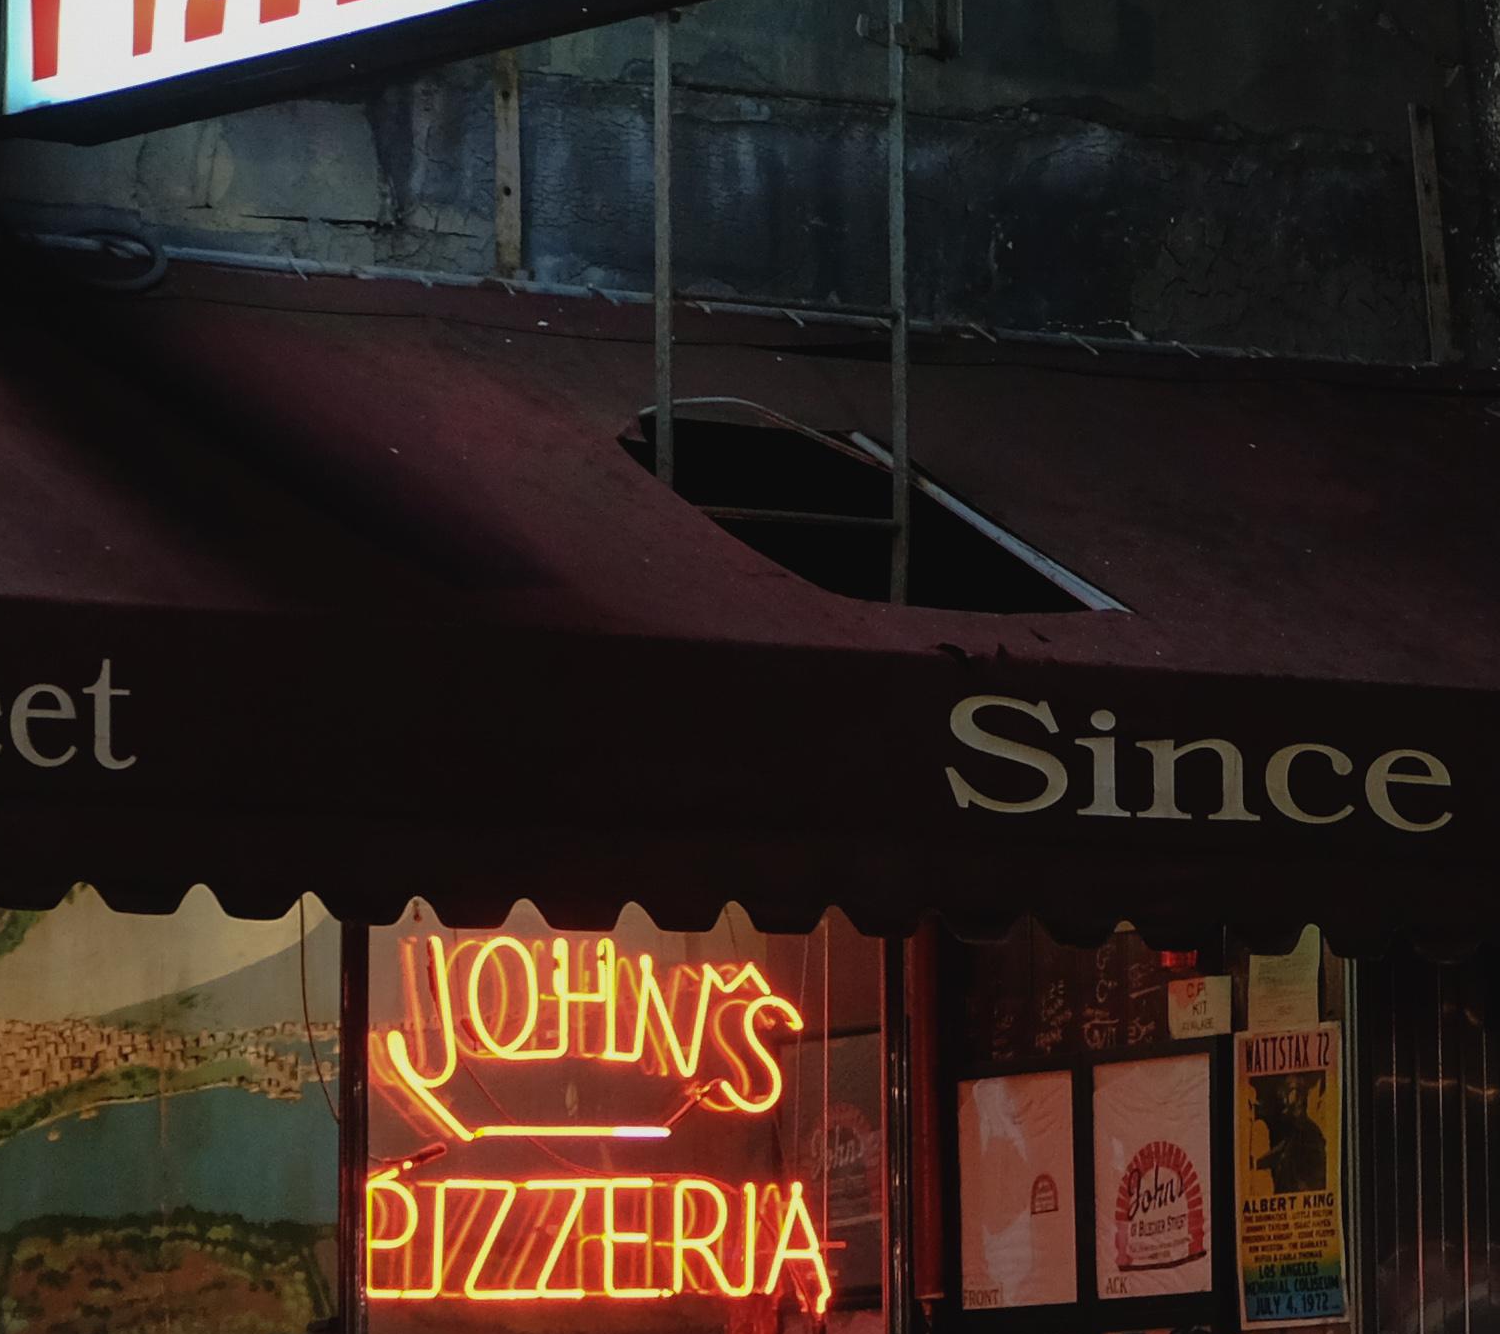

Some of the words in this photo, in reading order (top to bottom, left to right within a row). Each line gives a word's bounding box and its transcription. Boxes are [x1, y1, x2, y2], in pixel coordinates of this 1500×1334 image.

[944, 692, 1453, 834] Since
[387, 936, 803, 1113] JOHN'S
[1245, 1034, 1309, 1073] WATTSTAX
[366, 1169, 833, 1314] PIZZERIA
[1242, 1195, 1297, 1214] ALBERT
[1303, 1193, 1334, 1209] KING
[1302, 1292, 1329, 1313] 1972
